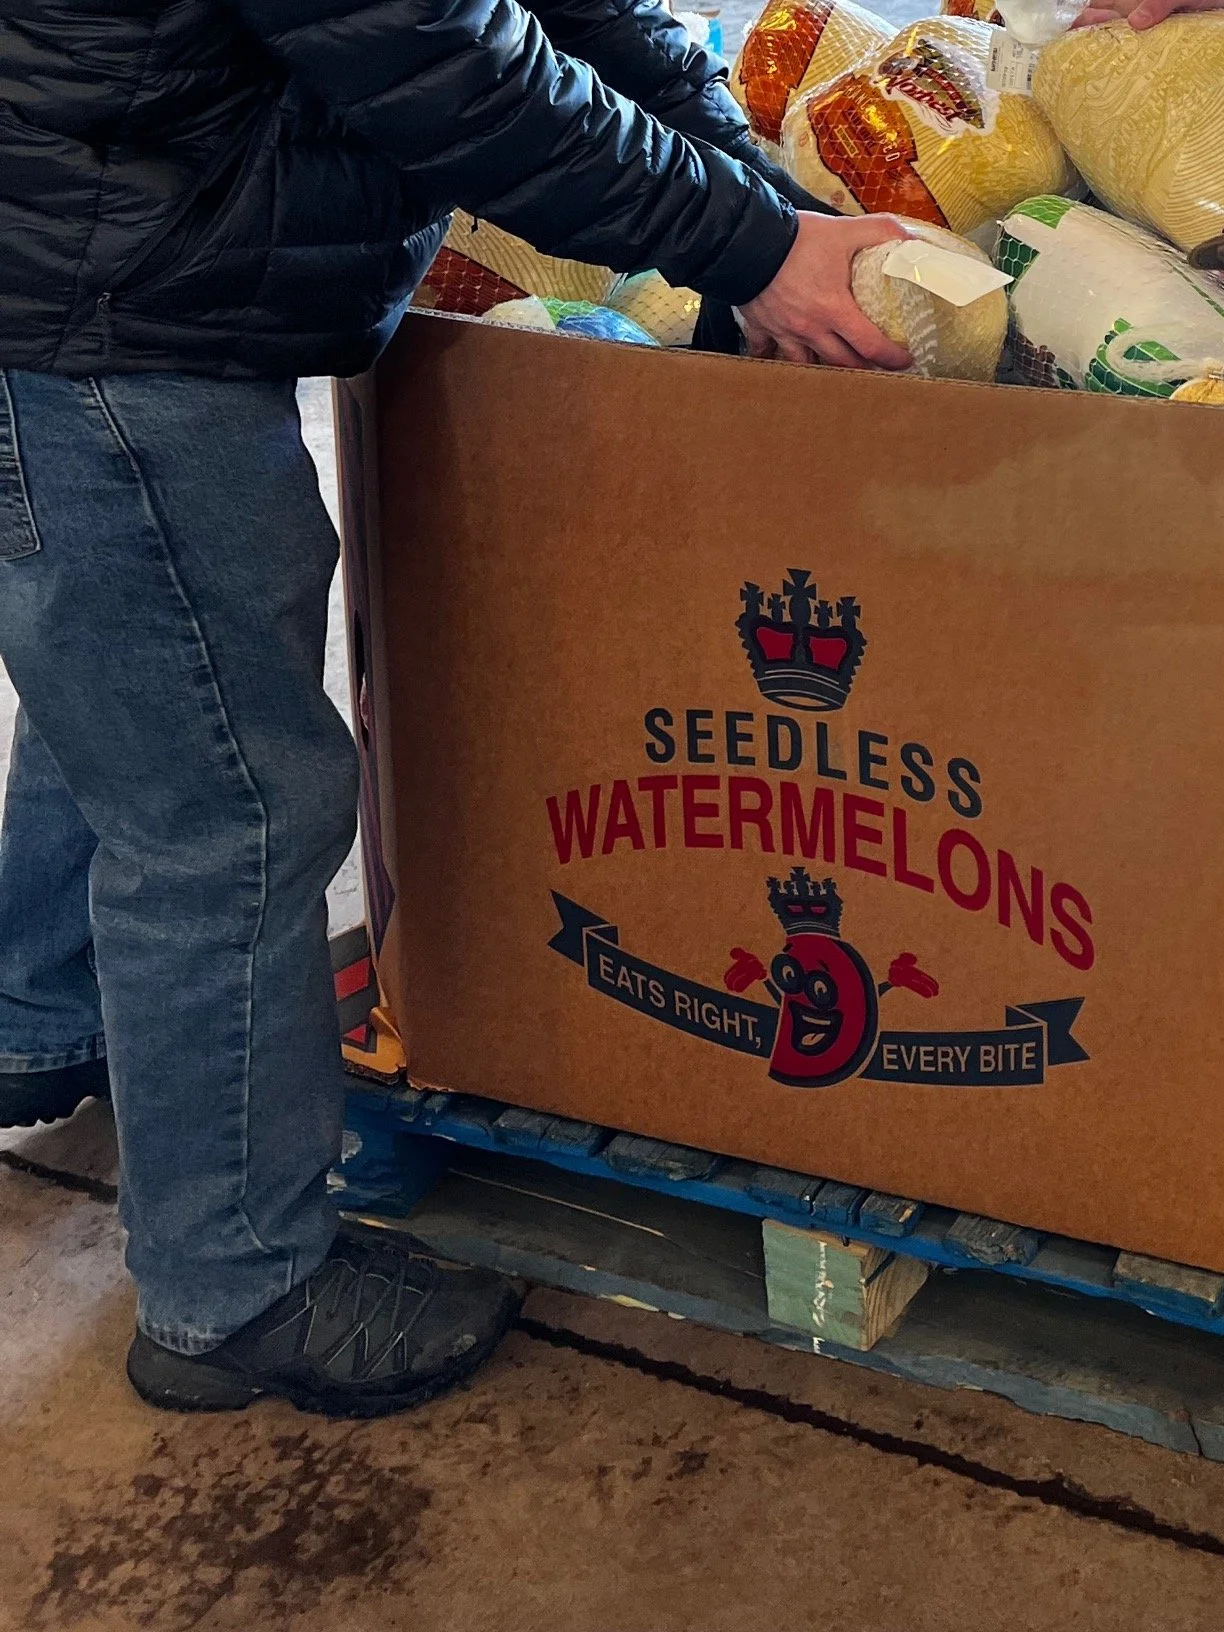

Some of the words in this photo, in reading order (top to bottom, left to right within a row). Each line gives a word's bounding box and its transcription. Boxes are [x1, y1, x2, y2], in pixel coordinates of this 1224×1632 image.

[644, 706, 983, 819] SEEDLESS
[546, 774, 1095, 971] WATERMELONS
[599, 953, 667, 1008] EATS
[674, 991, 761, 1049] RIGHT,
[882, 1043, 971, 1073] EVERY
[979, 1042, 1037, 1073] BITE
